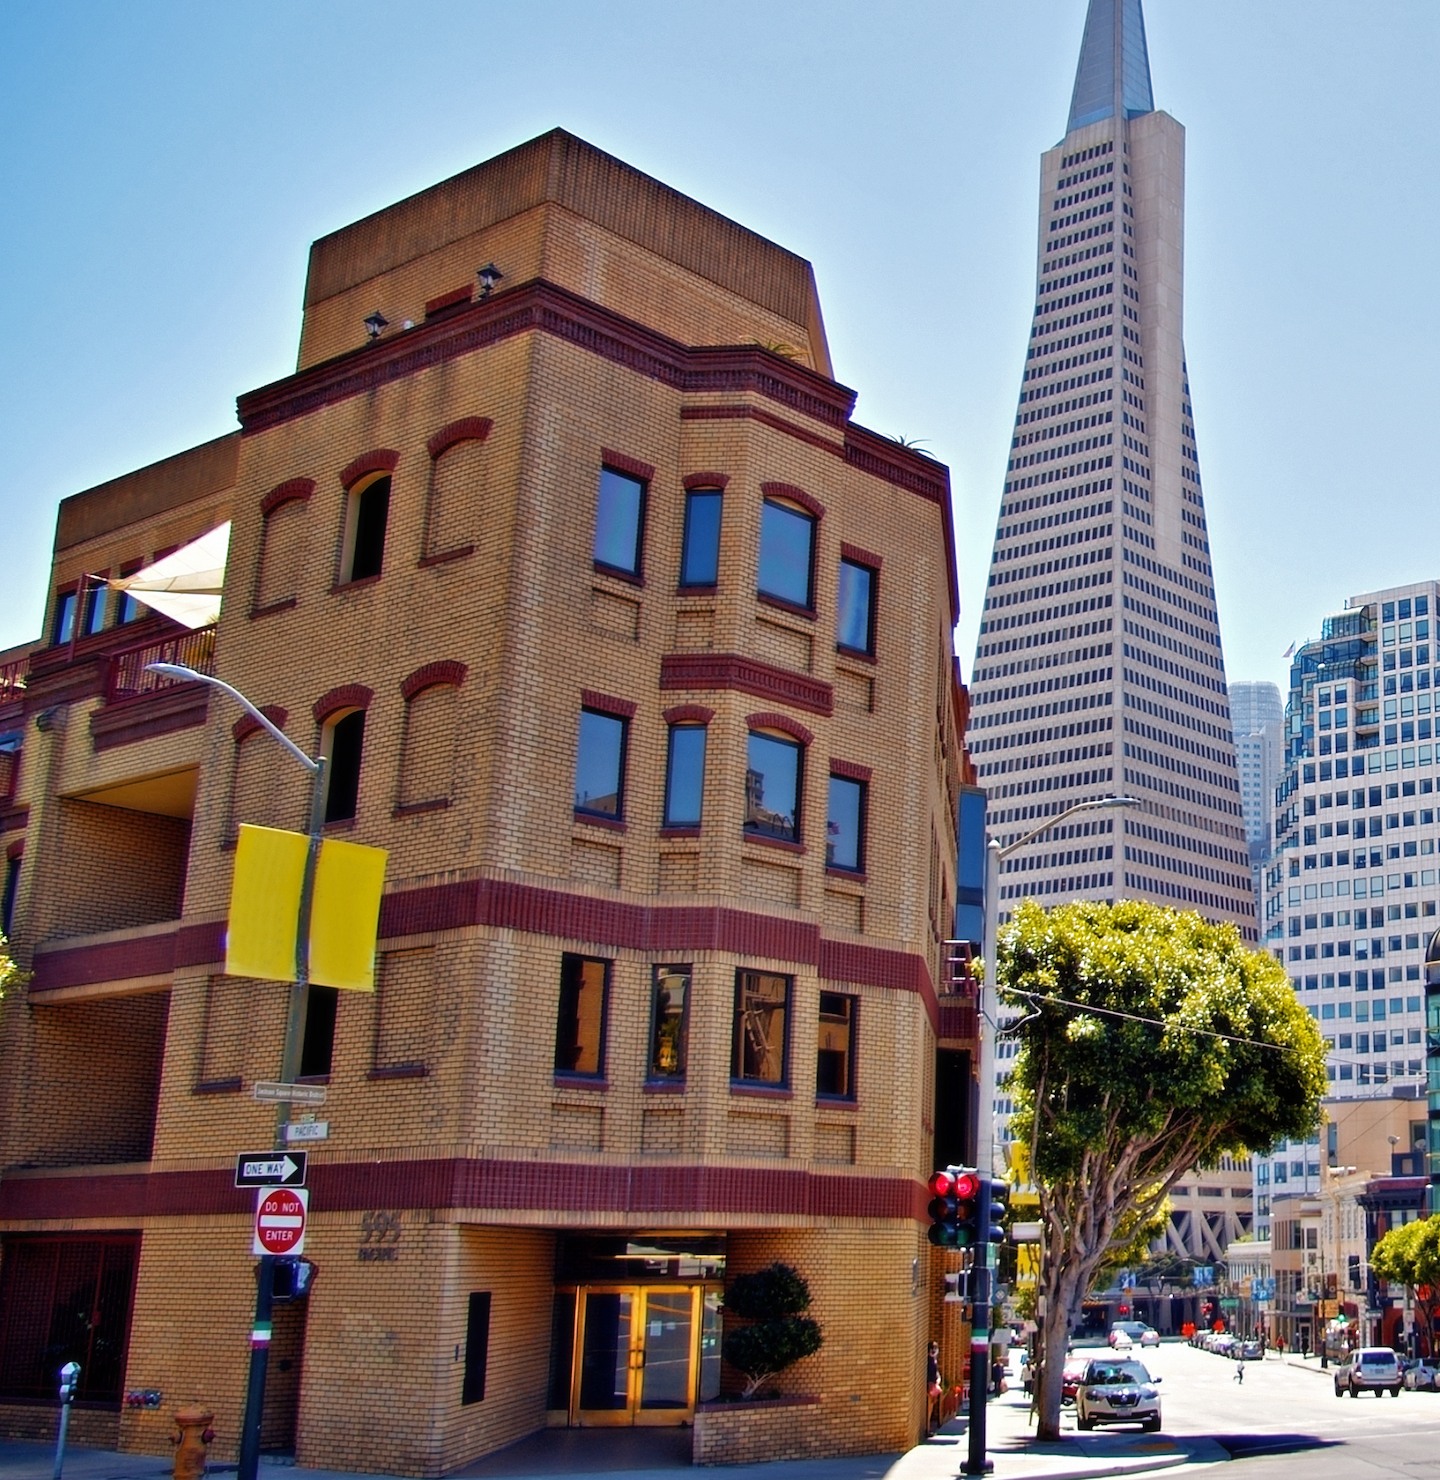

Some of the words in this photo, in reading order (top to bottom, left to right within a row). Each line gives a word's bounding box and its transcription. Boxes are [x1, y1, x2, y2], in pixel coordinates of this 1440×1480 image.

[245, 1163, 264, 1175] ONE
[266, 1163, 286, 1175] WAY
[265, 1201, 278, 1212] DO
[282, 1202, 300, 1213] NOT
[265, 1230, 293, 1241] ENTER
